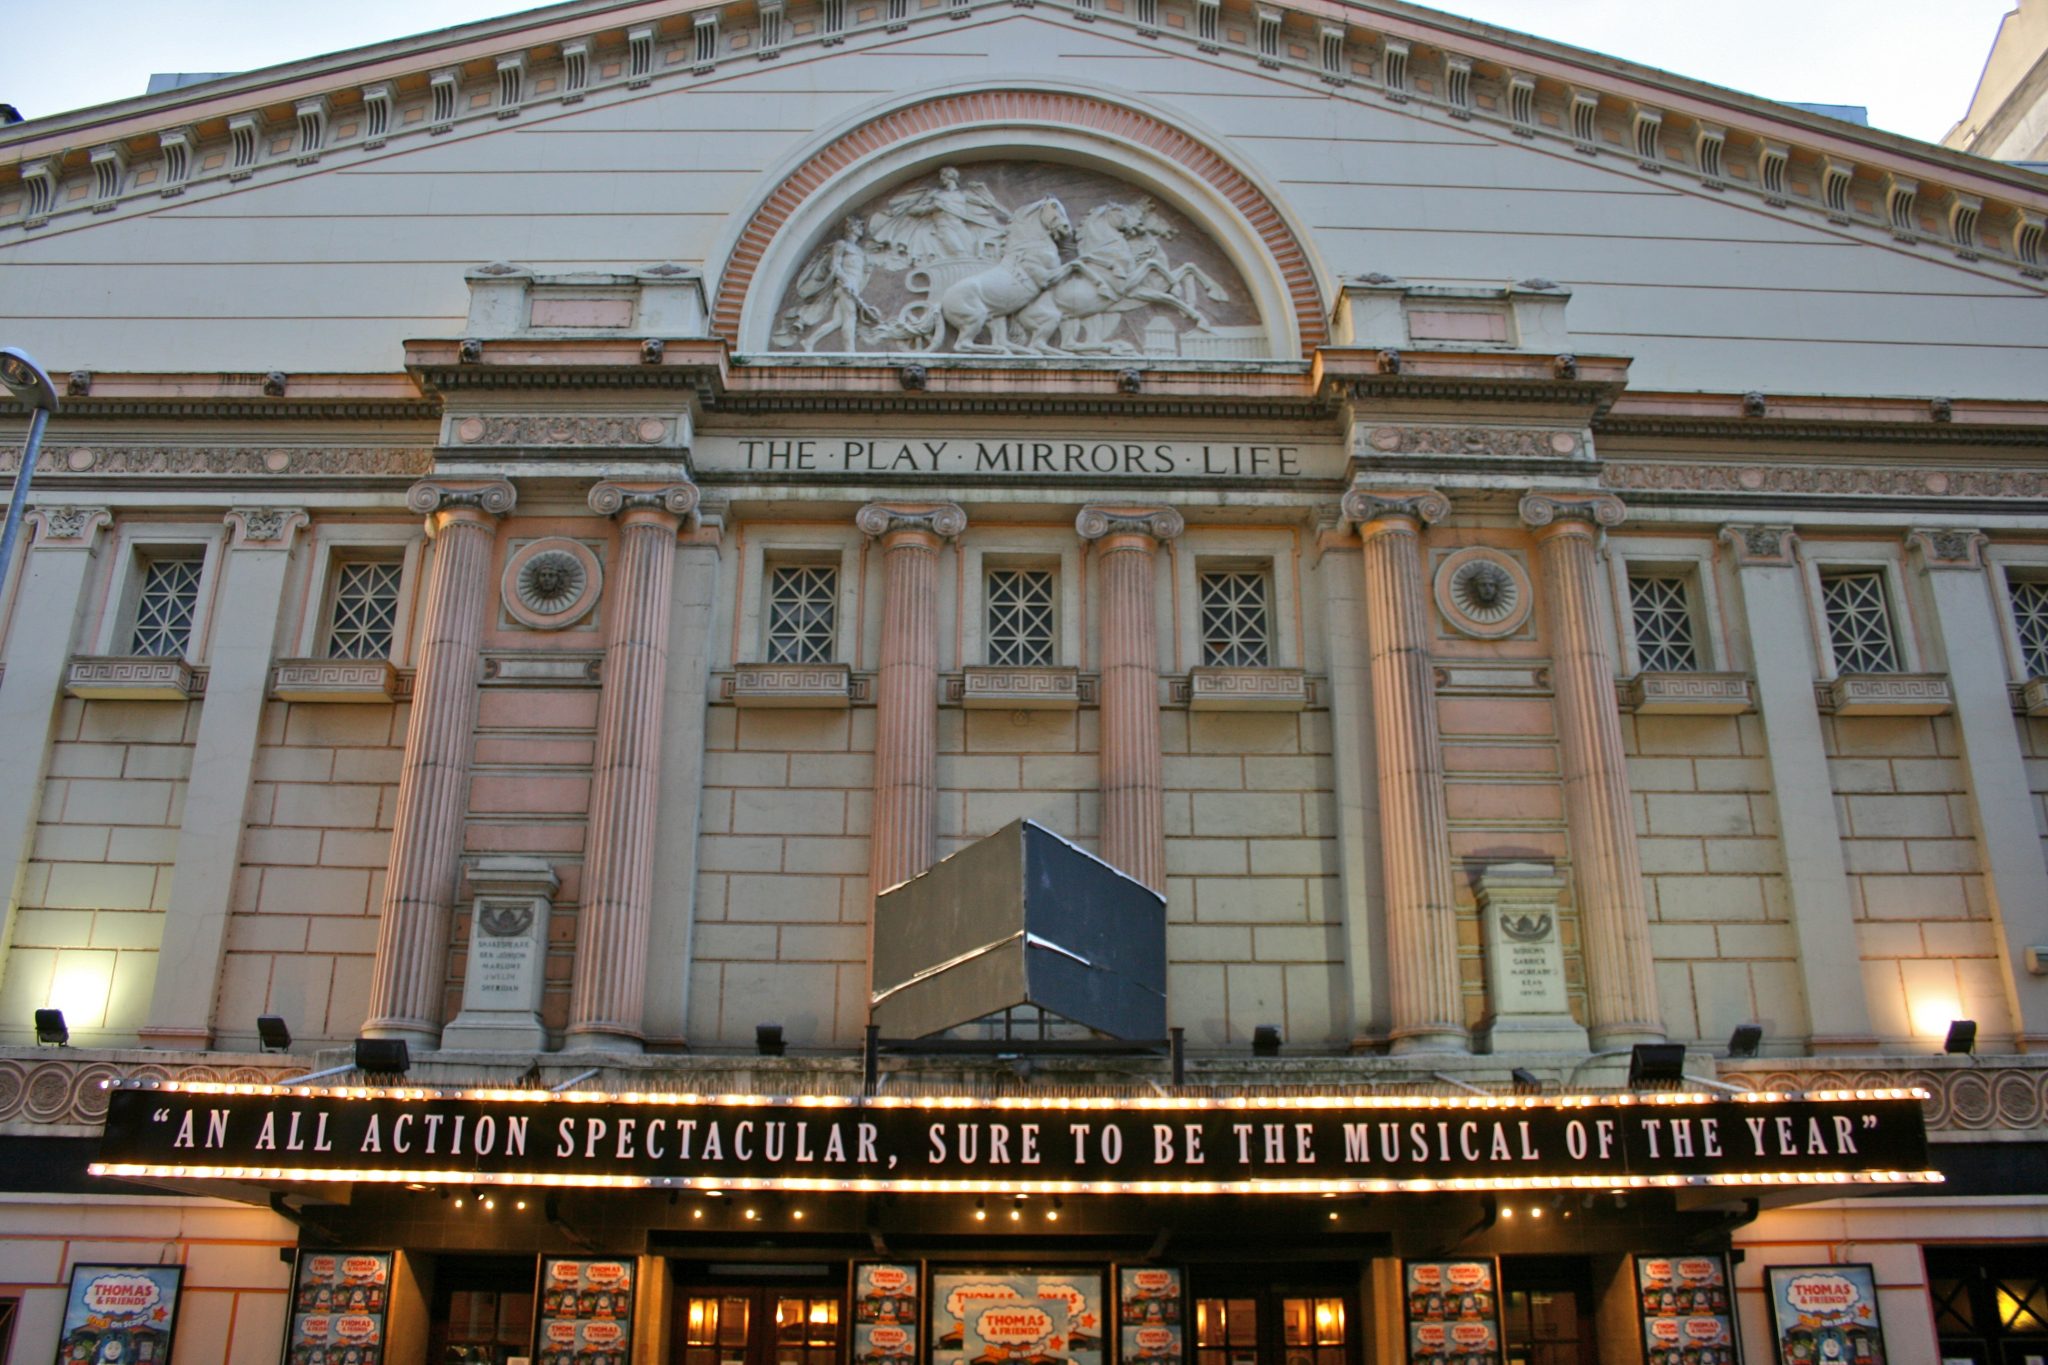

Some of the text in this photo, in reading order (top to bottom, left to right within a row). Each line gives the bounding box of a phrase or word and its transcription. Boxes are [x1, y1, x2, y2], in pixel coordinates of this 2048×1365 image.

[739, 441, 1301, 475] THE PLAY MIRRORS LIFE
[255, 1111, 332, 1151] ALL
[360, 1113, 529, 1156] ACTION
[557, 1117, 897, 1169] SPECTACULAR,
[929, 1123, 1040, 1164] SURE
[1070, 1123, 1122, 1164] TO
[1153, 1124, 1205, 1164] BE
[1233, 1123, 1316, 1164] THE
[1342, 1120, 1539, 1163] MUSICAL
[1566, 1120, 1614, 1160] OF
[1641, 1118, 1722, 1158] THE
[95, 1285, 153, 1296] THOMAS
[1794, 1284, 1851, 1295] THOMAS
[96, 1297, 147, 1305] & FRIENDS
[1800, 1296, 1848, 1304] & FRIENDS
[986, 1315, 1045, 1326] THOMAS
[999, 1328, 1041, 1336] FRIENDS
